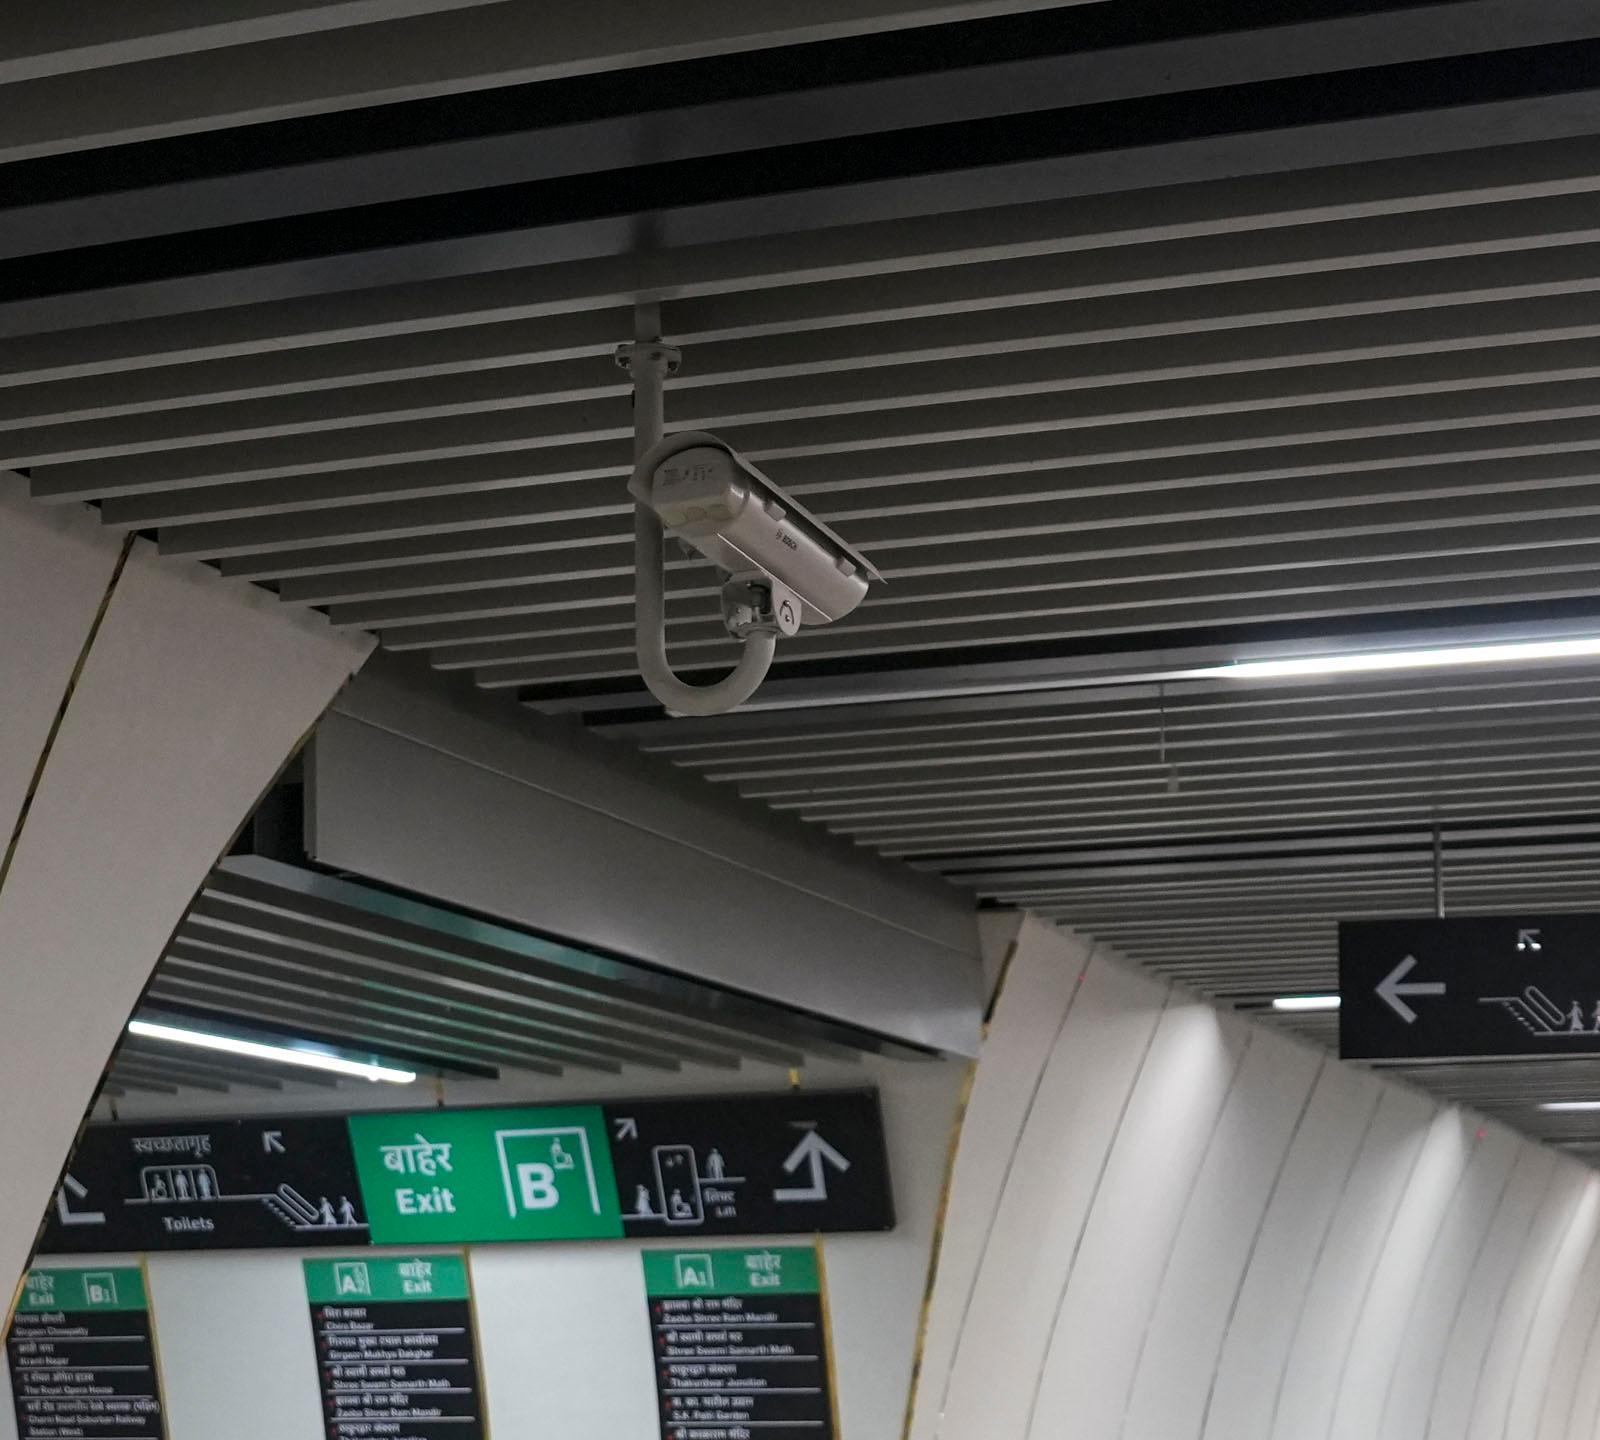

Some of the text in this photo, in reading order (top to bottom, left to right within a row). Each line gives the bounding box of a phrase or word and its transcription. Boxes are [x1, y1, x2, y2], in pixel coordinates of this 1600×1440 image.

[379, 1133, 452, 1178] बाहेर
[395, 1187, 456, 1216] Exit
[162, 1214, 215, 1234] Toilets
